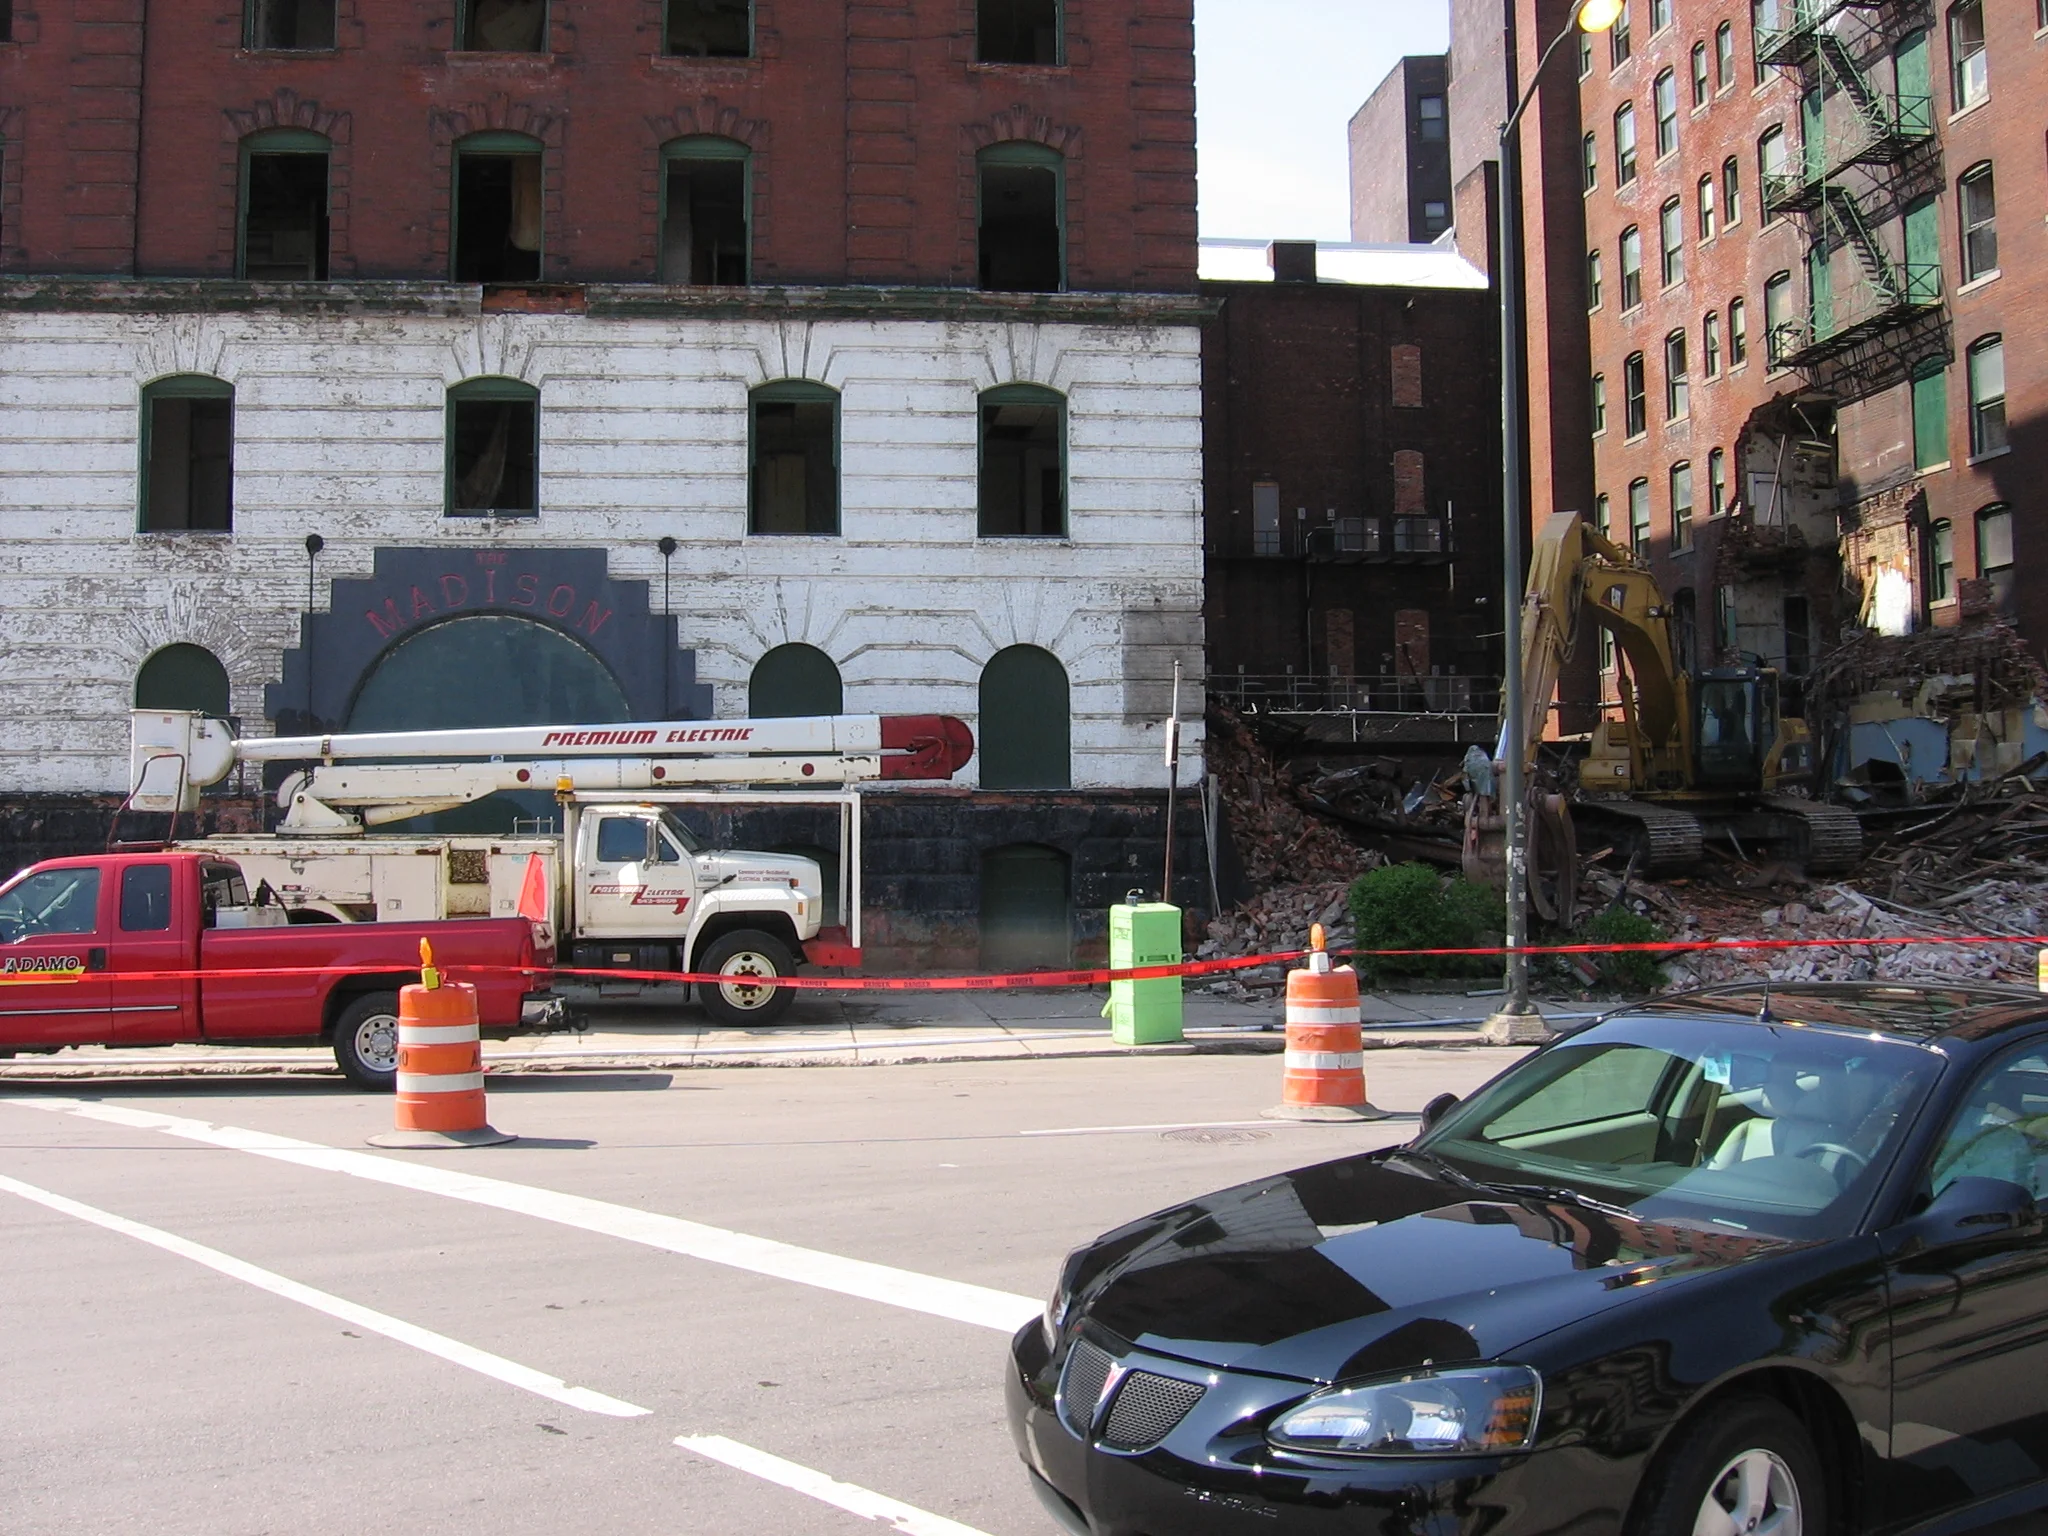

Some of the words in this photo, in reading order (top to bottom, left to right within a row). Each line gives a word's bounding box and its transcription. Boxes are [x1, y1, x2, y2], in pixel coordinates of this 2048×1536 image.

[366, 569, 612, 638] MADISON
[542, 730, 658, 747] PREMIUM
[665, 728, 755, 743] ELECTRIC
[4, 956, 81, 974] ADAMO
